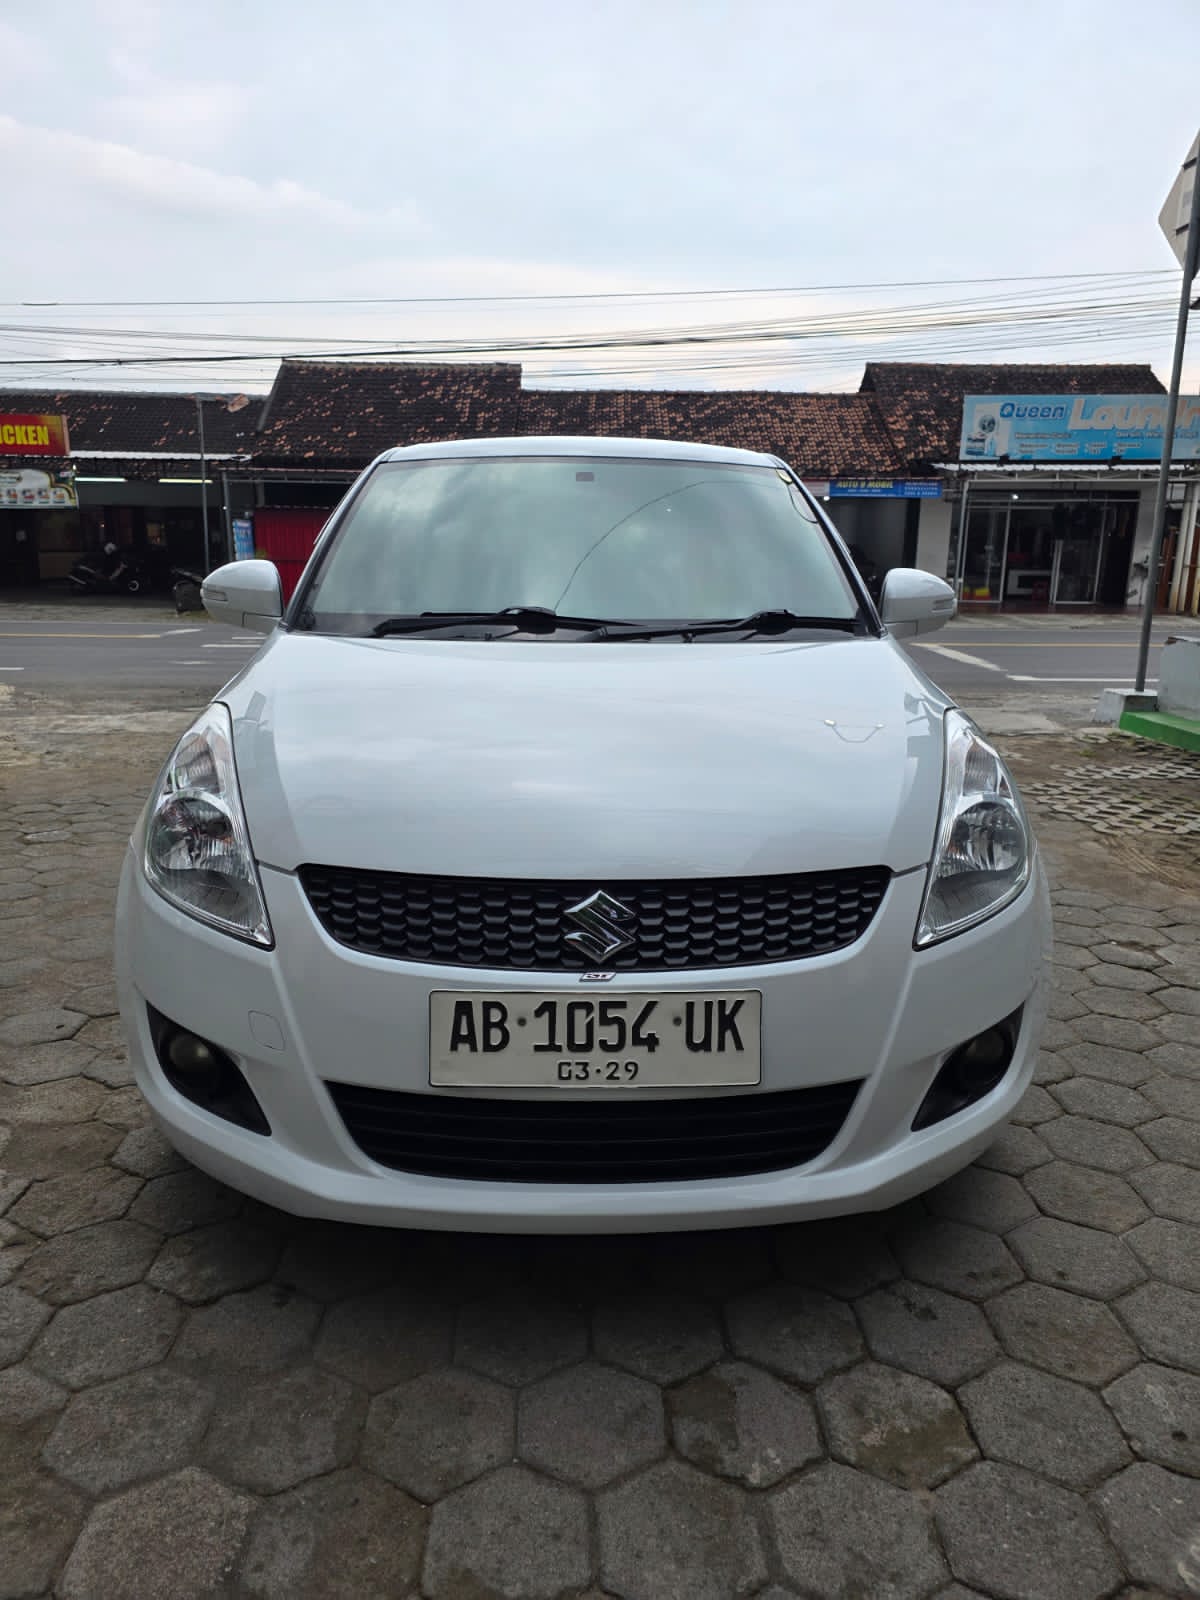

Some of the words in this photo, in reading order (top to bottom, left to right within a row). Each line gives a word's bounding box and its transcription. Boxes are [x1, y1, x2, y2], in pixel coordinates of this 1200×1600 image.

[999, 402, 1065, 418] Queen
[450, 1000, 511, 1052] AB
[533, 1000, 660, 1052] 1054
[685, 1000, 746, 1052] UK
